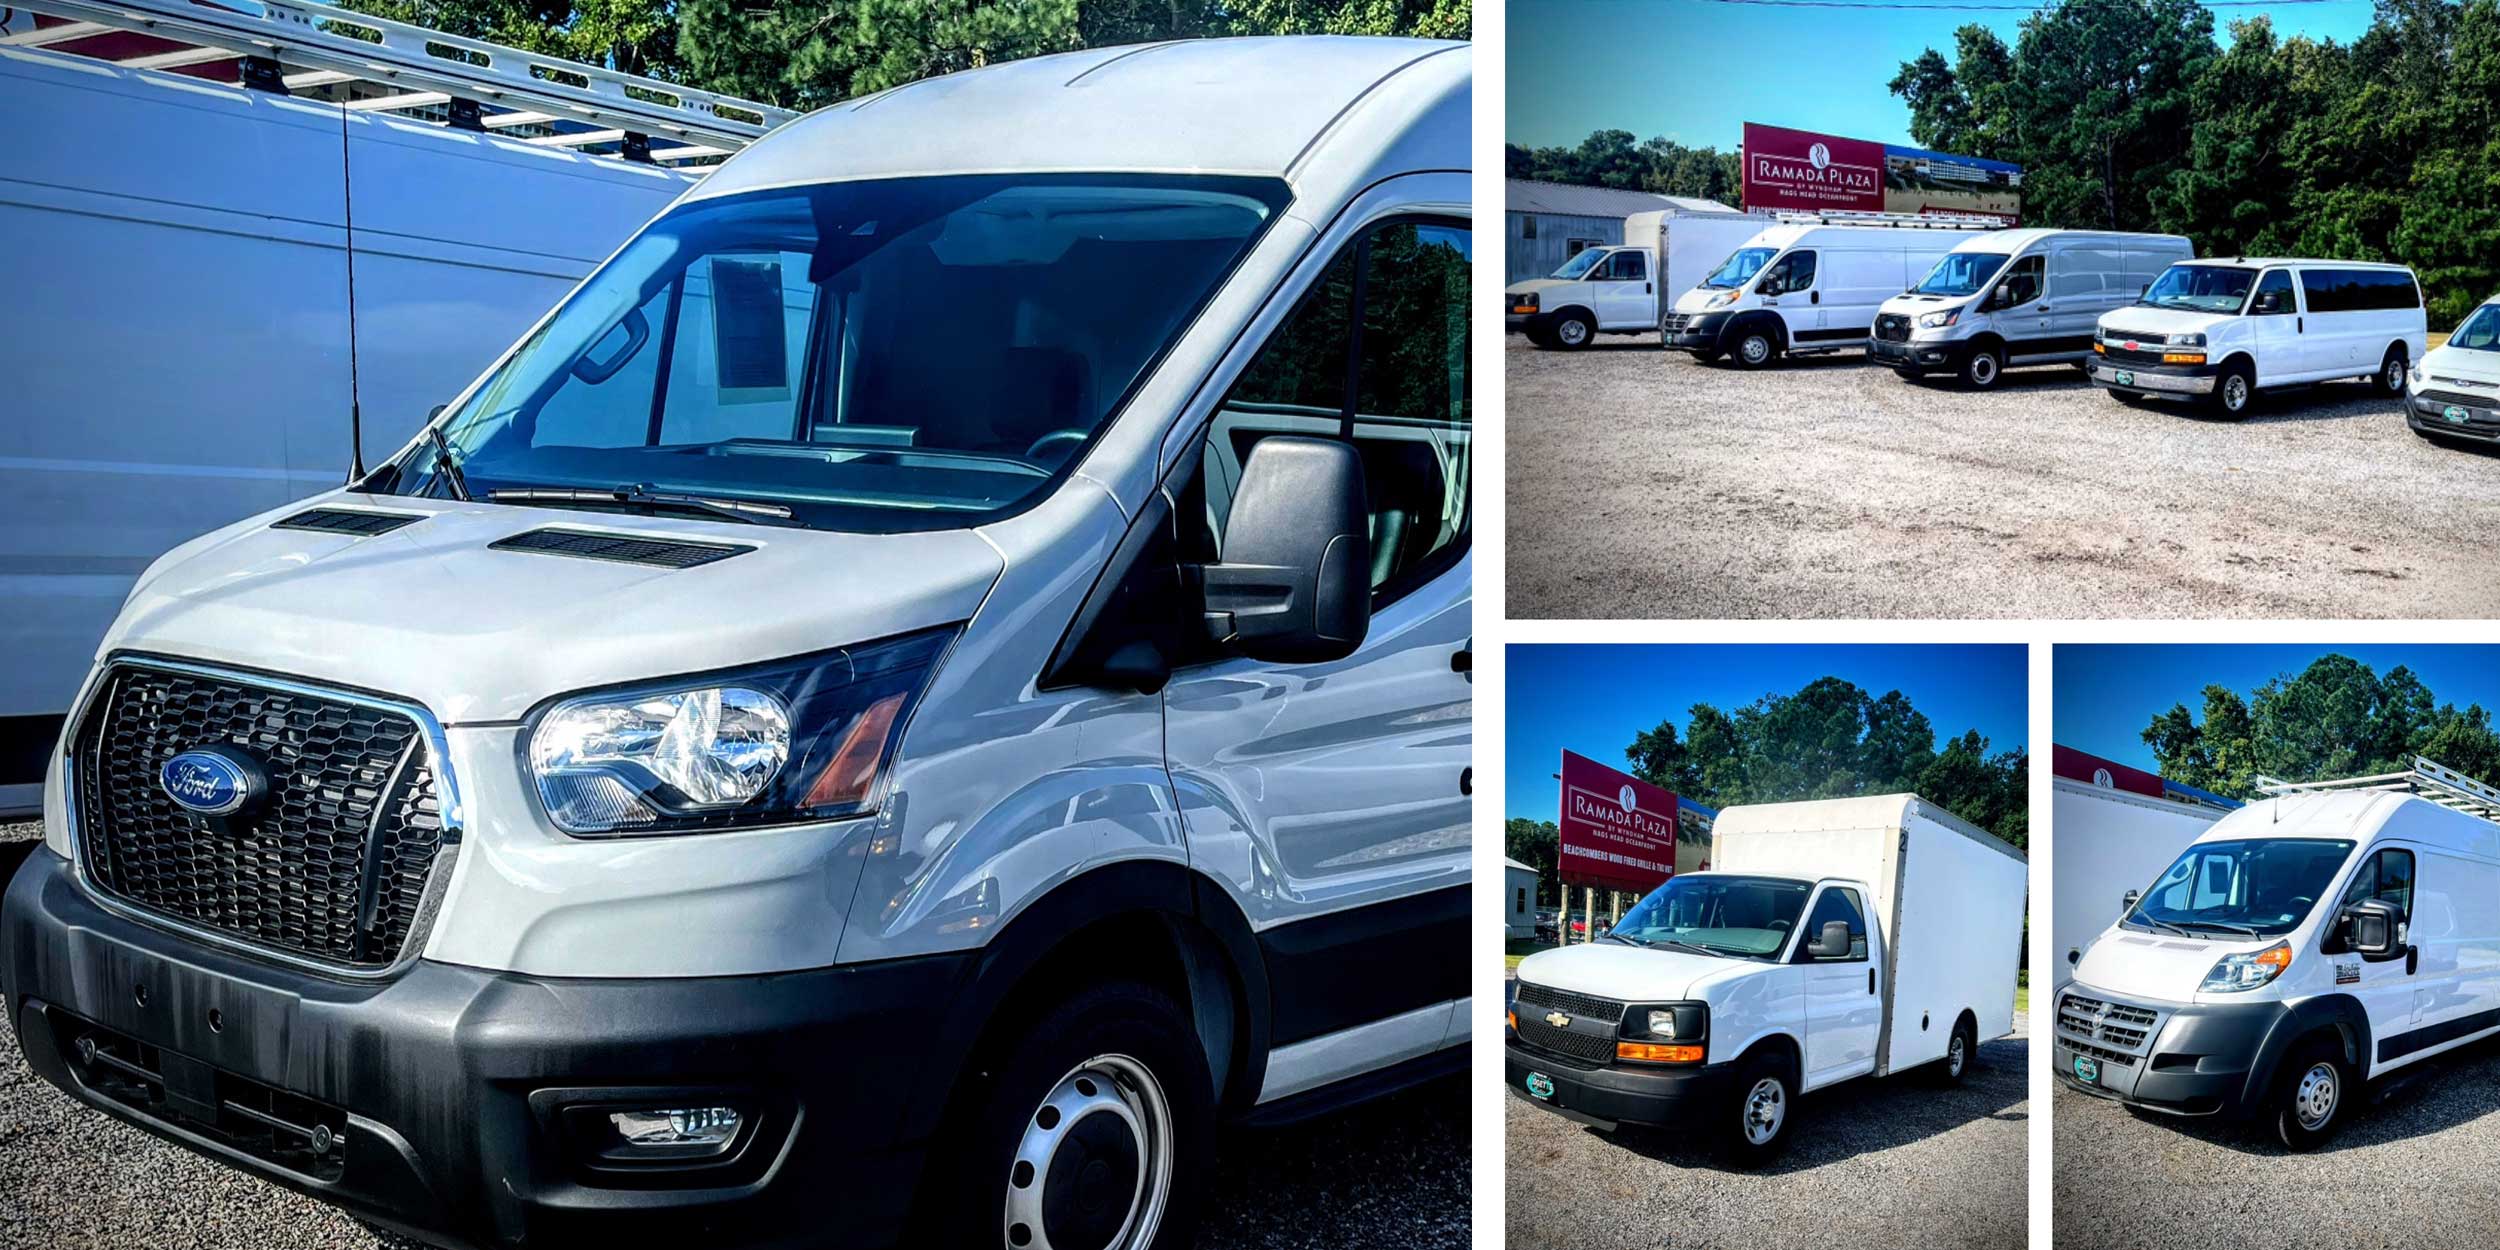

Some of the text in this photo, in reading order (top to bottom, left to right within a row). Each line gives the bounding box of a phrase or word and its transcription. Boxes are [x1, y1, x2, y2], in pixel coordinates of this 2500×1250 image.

[1760, 160, 1871, 187] RAMADA PLAZA
[172, 760, 220, 800] Ford
[1576, 795, 1667, 837] RAMADA PLAZA
[1592, 829, 1656, 851] NAGS HEAD OCEANFRONT
[1617, 827, 1645, 840] WYNDHAM
[1563, 843, 1608, 862] BEACHCOMBERS
[1609, 852, 1623, 865] WOOD
[1623, 855, 1637, 867] FIRED
[1637, 858, 1651, 871] GRILLE
